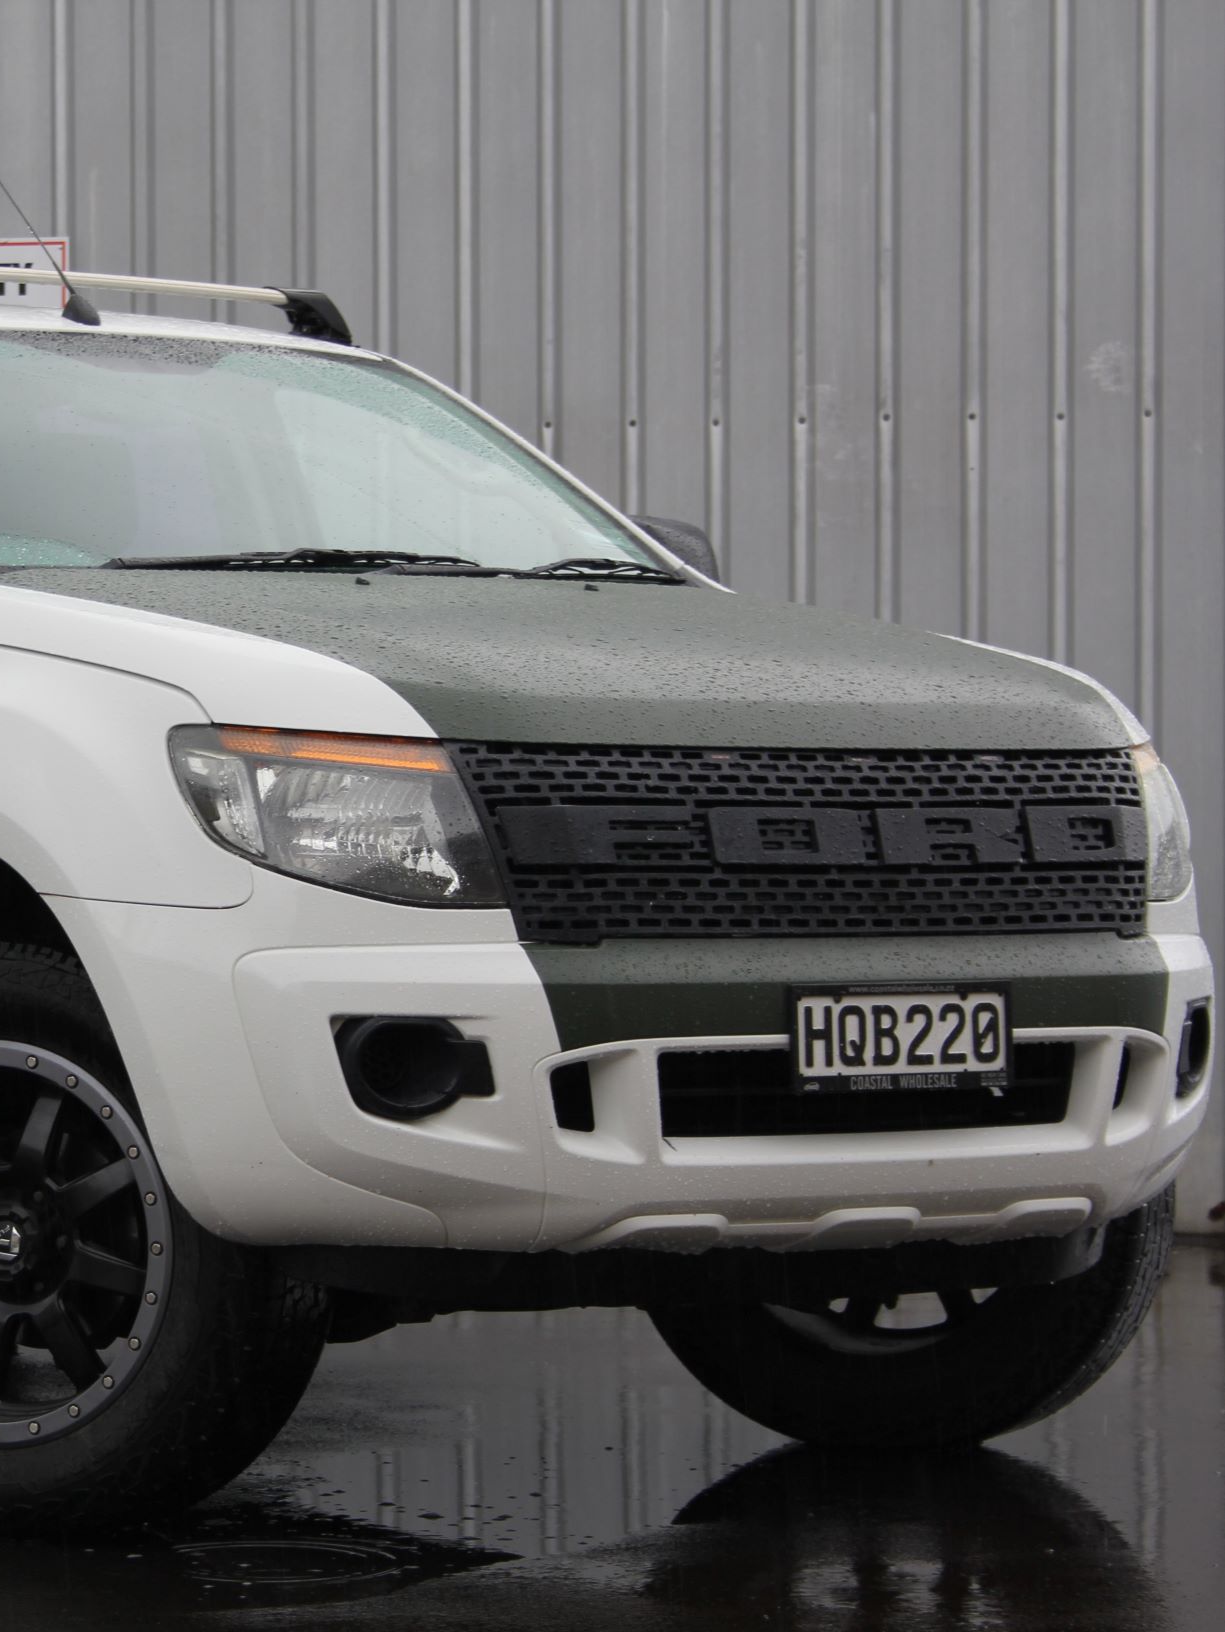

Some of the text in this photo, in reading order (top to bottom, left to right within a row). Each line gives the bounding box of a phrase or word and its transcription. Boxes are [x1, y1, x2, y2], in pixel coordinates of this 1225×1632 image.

[804, 1003, 1000, 1068] HQB220
[850, 1074, 958, 1090] COASTAL WHOLESALE
